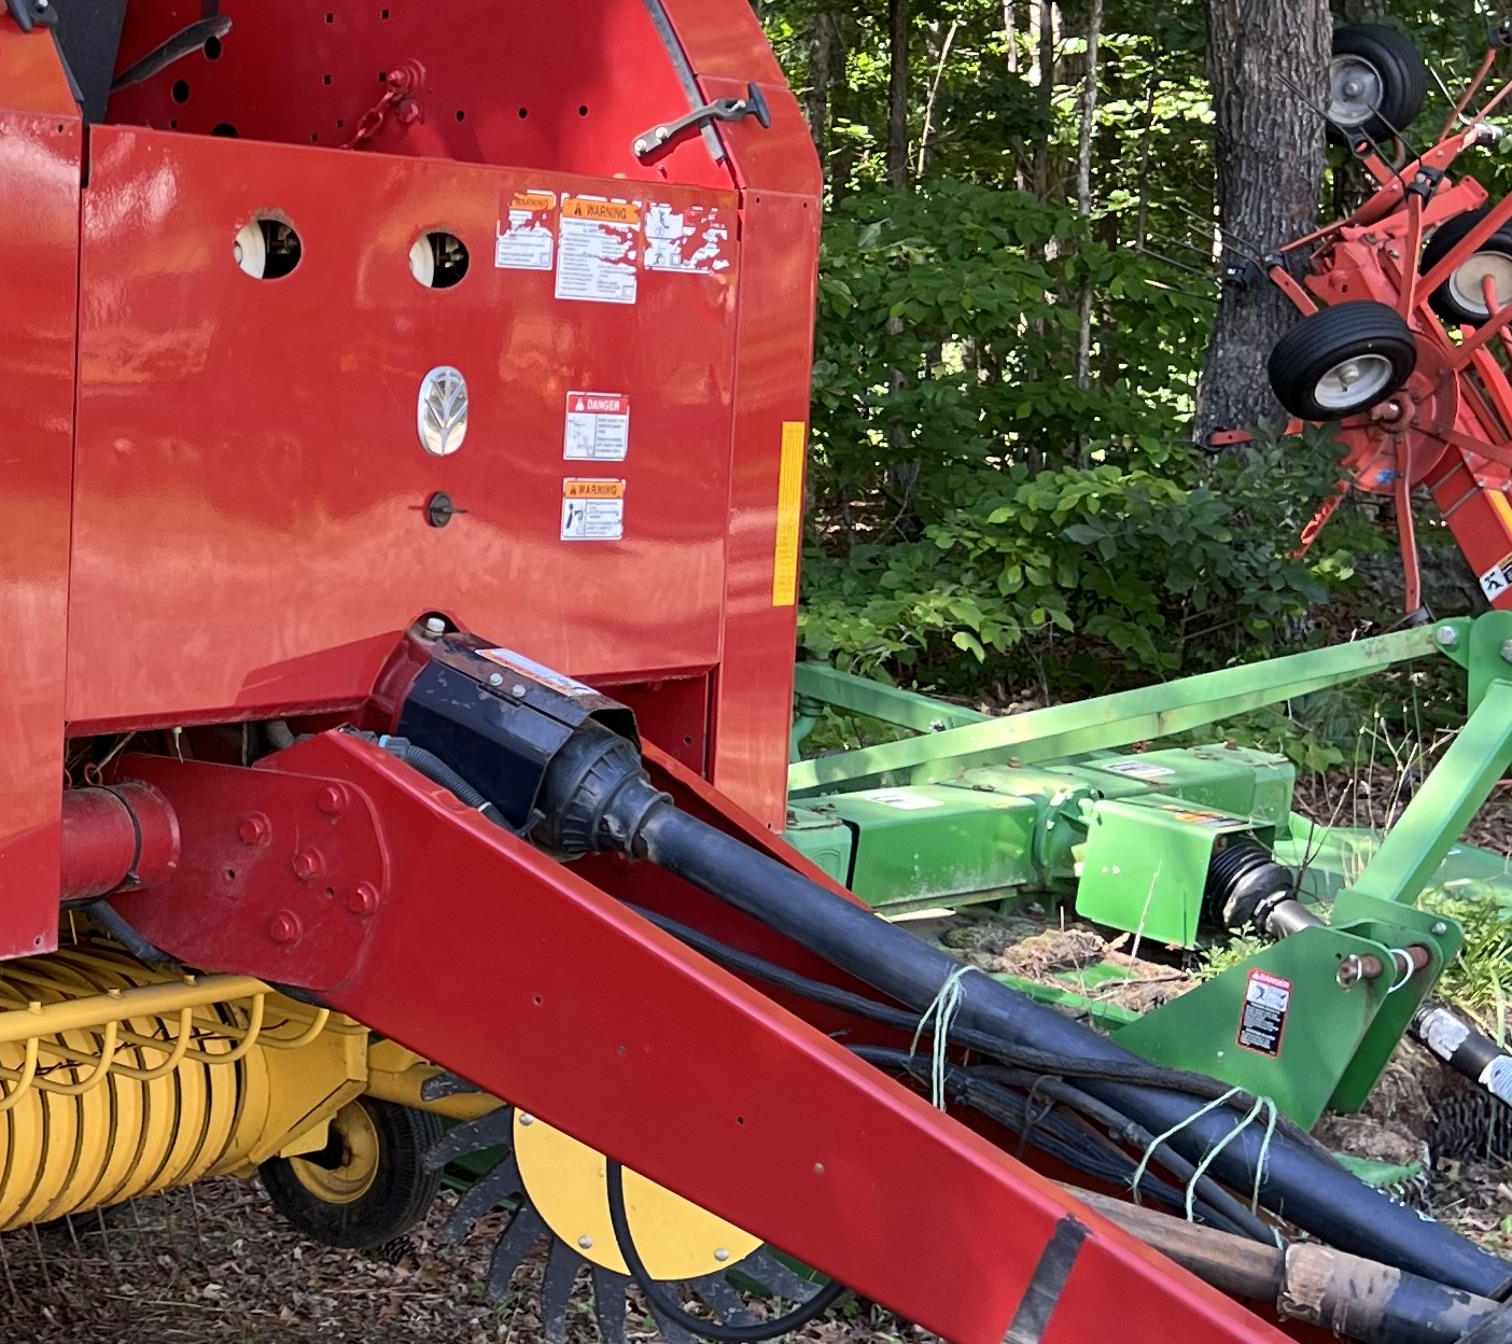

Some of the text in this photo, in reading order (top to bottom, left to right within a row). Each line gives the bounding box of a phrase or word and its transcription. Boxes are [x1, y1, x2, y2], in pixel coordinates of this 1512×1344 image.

[588, 204, 627, 219] WARNING
[587, 399, 620, 411] DANGER
[579, 484, 617, 496] WARNING
